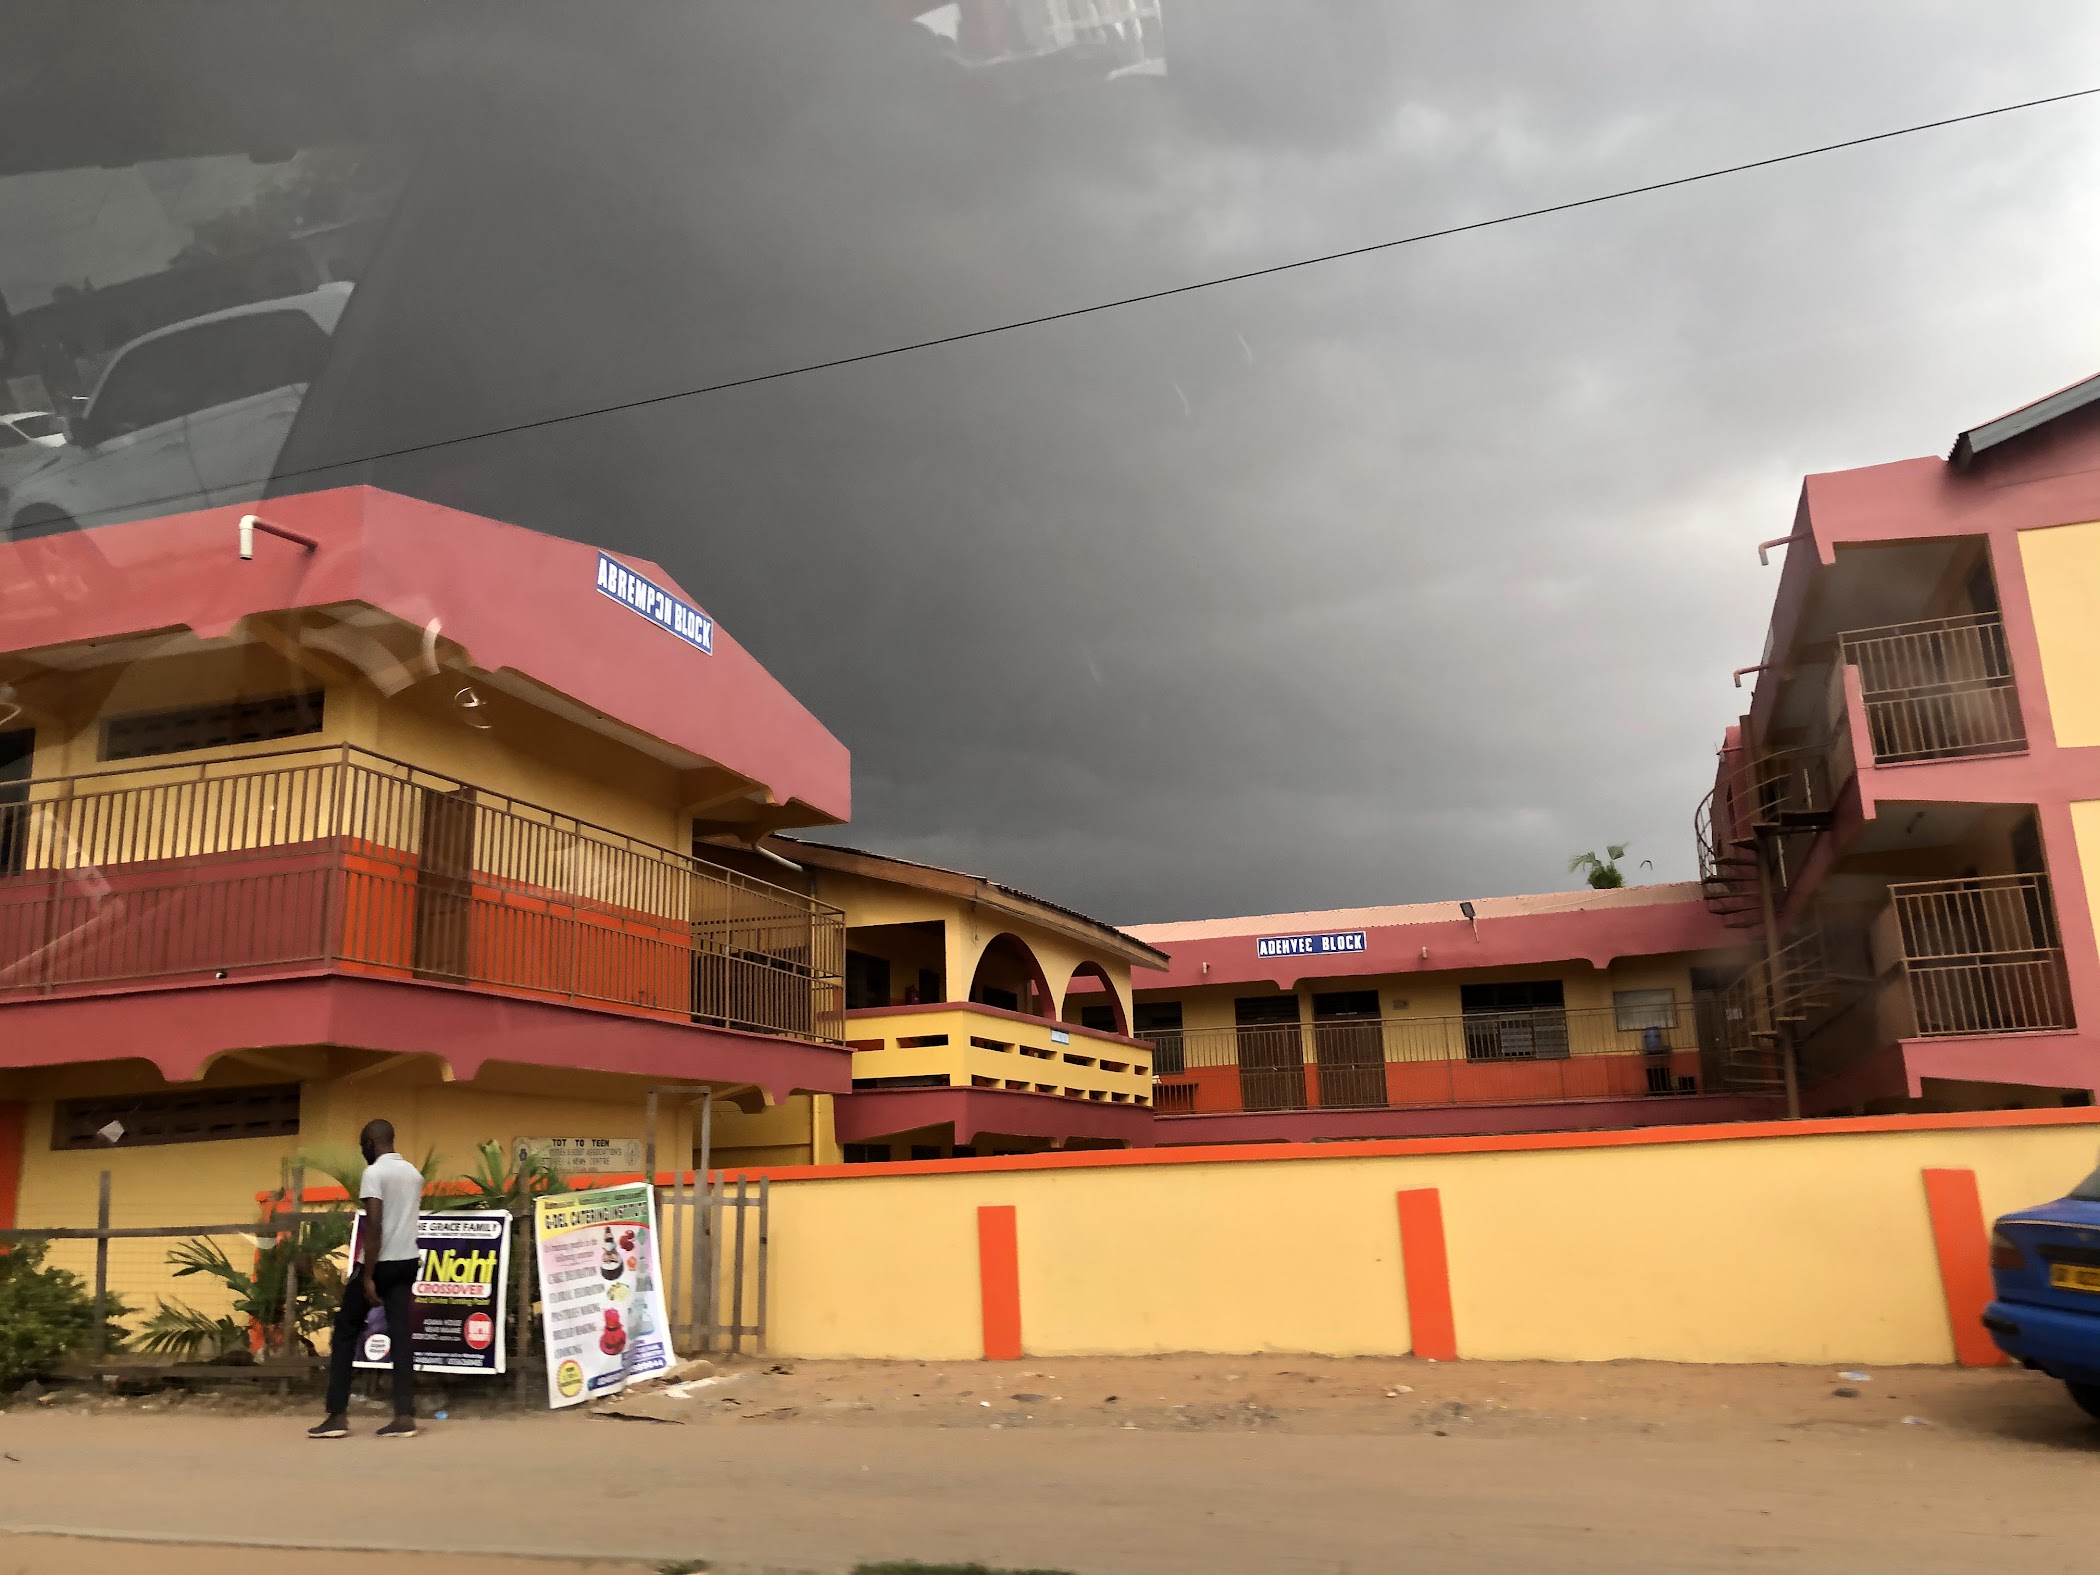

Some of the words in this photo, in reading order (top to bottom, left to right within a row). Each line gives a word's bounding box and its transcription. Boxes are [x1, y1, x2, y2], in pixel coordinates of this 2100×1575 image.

[674, 603, 711, 649] BLOCK
[1322, 935, 1362, 951] BLOCK
[552, 1139, 567, 1147] TOT
[575, 1139, 584, 1147] TO
[592, 1139, 610, 1147] TEEN
[429, 1222, 460, 1231] GRACE
[463, 1223, 497, 1232] FAMILY
[425, 1249, 497, 1284] Night
[417, 1283, 484, 1295] CROSSOVER
